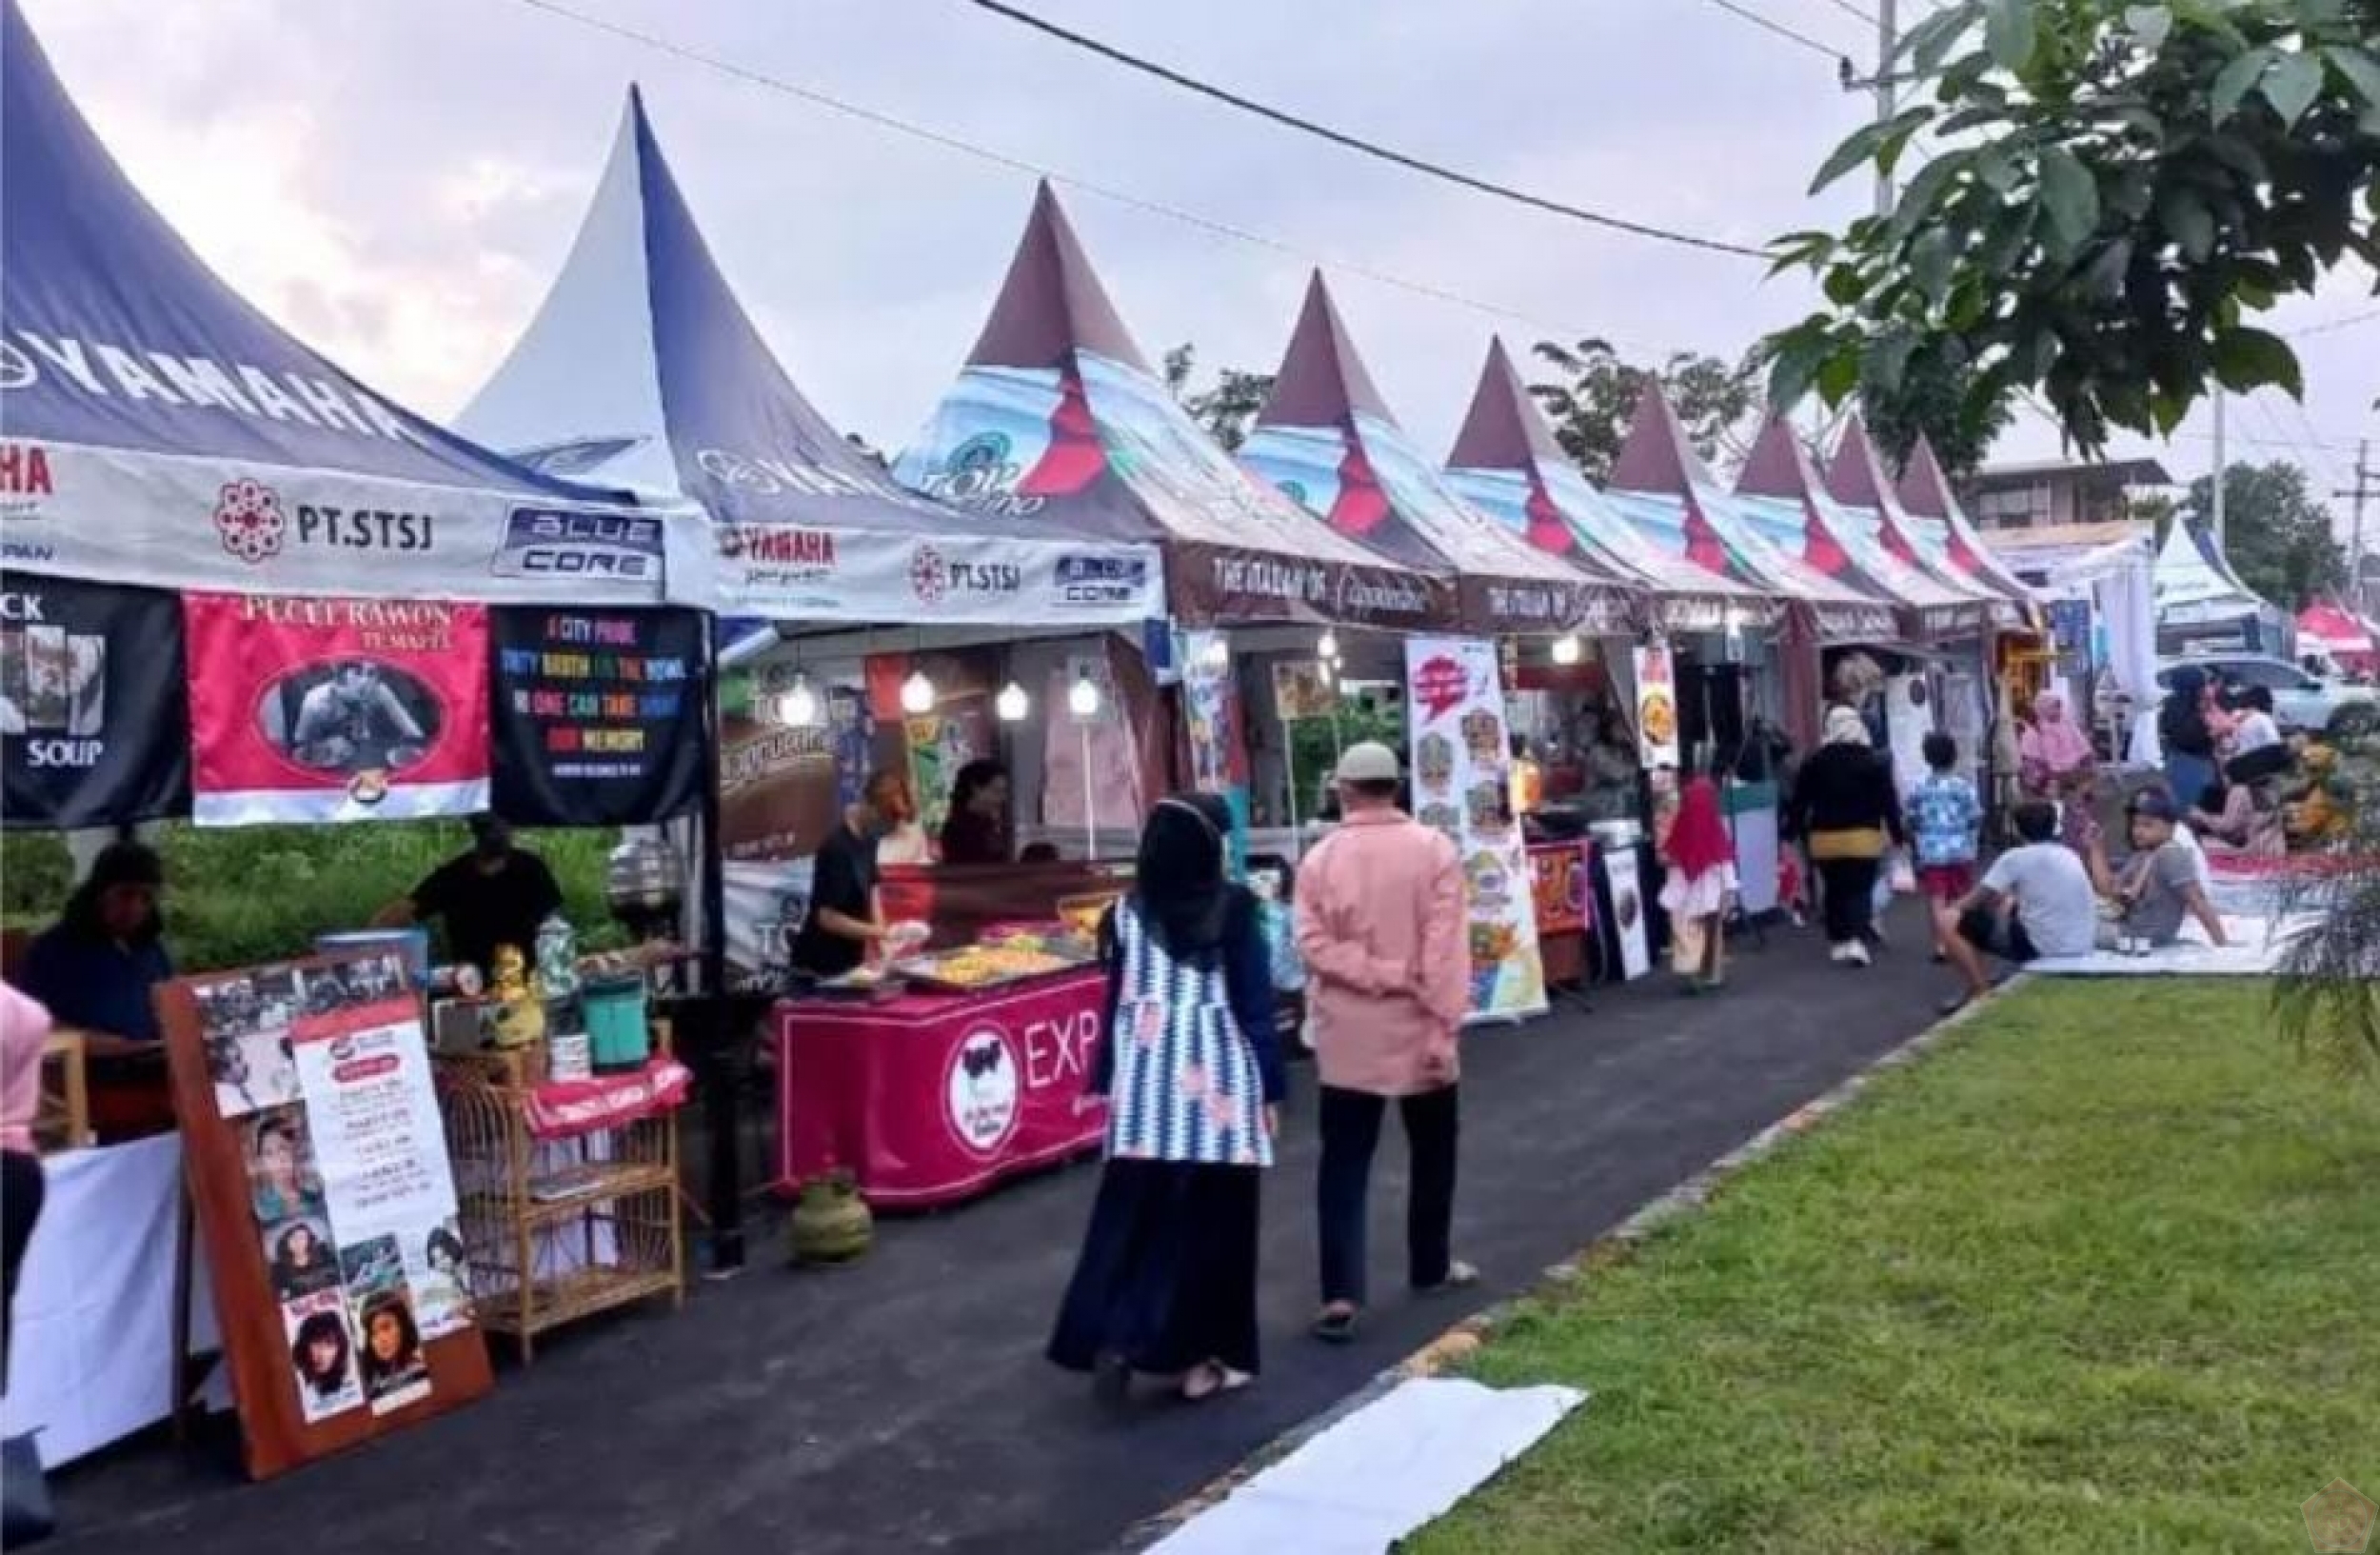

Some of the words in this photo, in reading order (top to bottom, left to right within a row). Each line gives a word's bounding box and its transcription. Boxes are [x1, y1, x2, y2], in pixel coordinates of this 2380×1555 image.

[297, 504, 433, 550] PT.STSJ
[528, 512, 664, 544] BLUE
[522, 549, 647, 576] CORE
[744, 527, 836, 566] YAMAHA
[27, 738, 105, 768] SOUP
